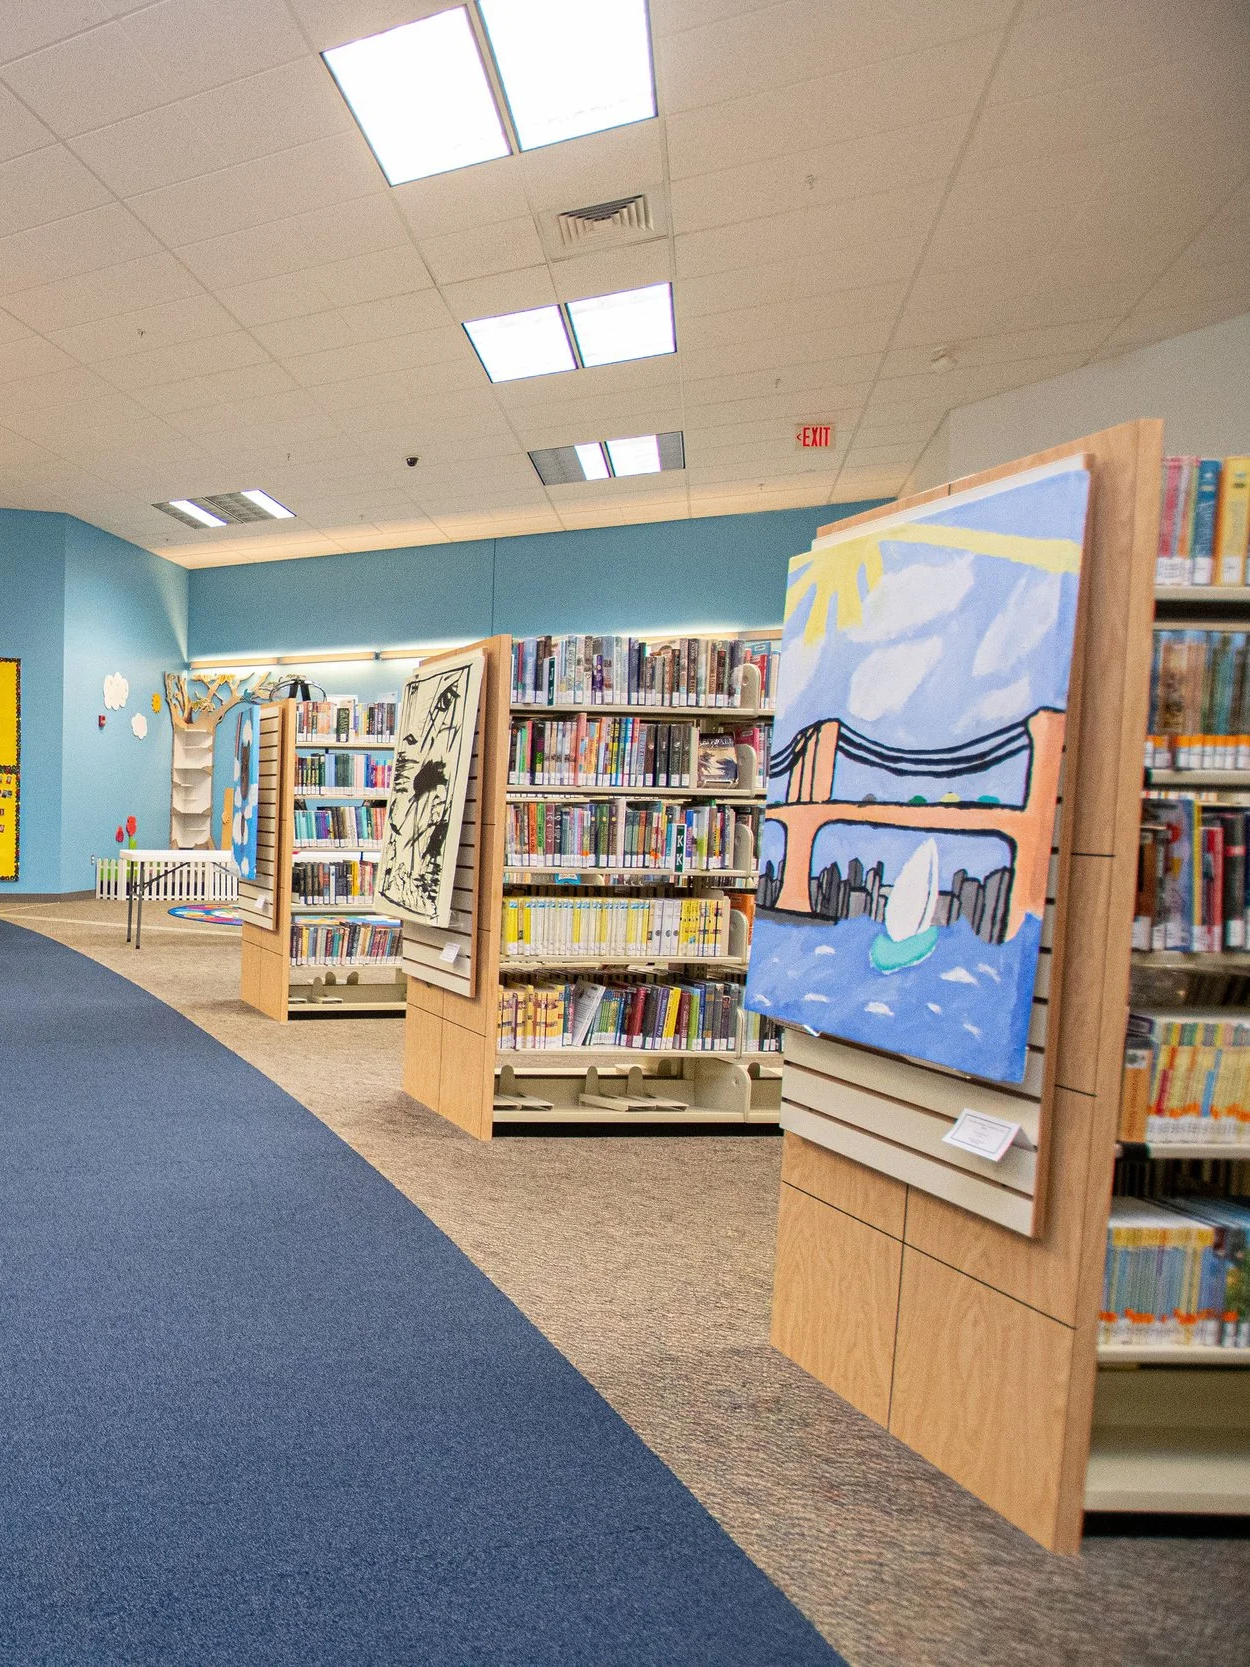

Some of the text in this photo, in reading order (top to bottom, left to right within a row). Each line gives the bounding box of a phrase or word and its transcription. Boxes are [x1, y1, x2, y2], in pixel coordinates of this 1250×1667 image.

[803, 427, 830, 447] EXIT
[677, 835, 684, 847] K
[676, 853, 682, 866] K
